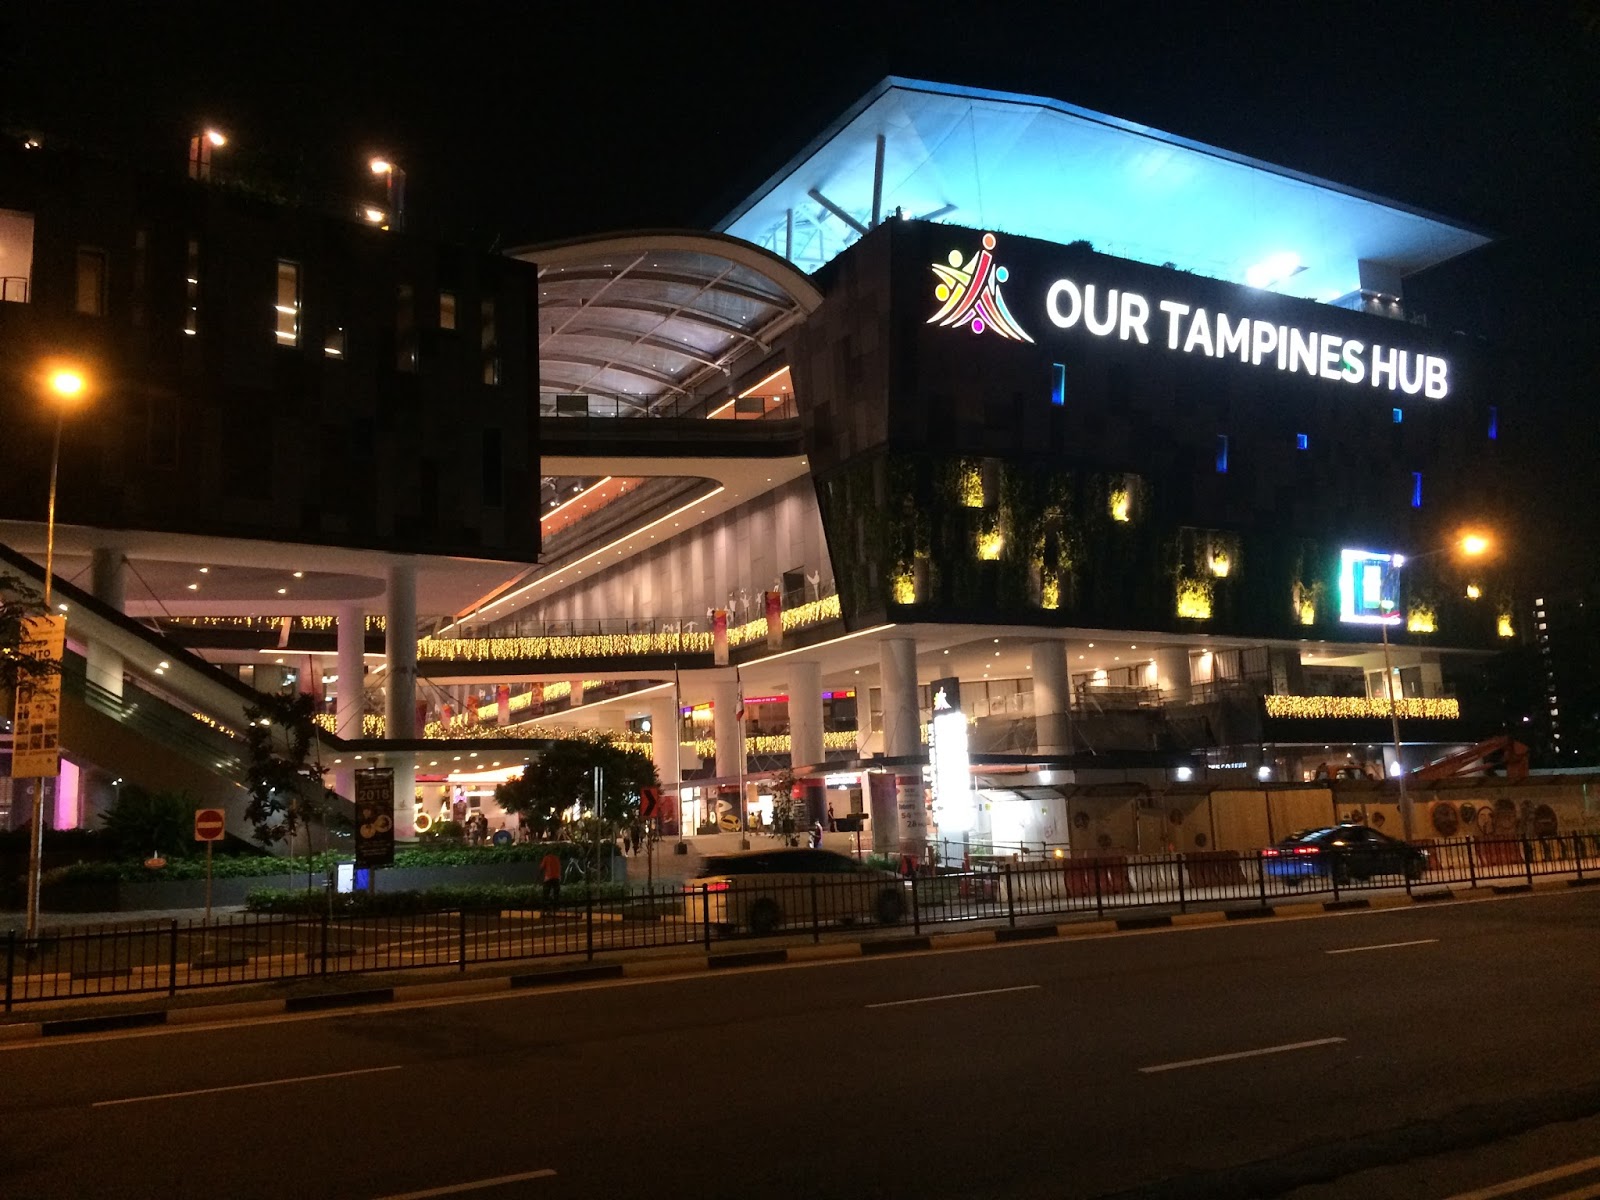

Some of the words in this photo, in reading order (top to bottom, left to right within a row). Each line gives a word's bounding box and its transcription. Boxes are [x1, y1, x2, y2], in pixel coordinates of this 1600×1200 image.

[1046, 279, 1149, 345] OUR
[1160, 299, 1365, 384] TAMPINES
[1371, 344, 1449, 400] HUB
[360, 789, 389, 800] 2018
